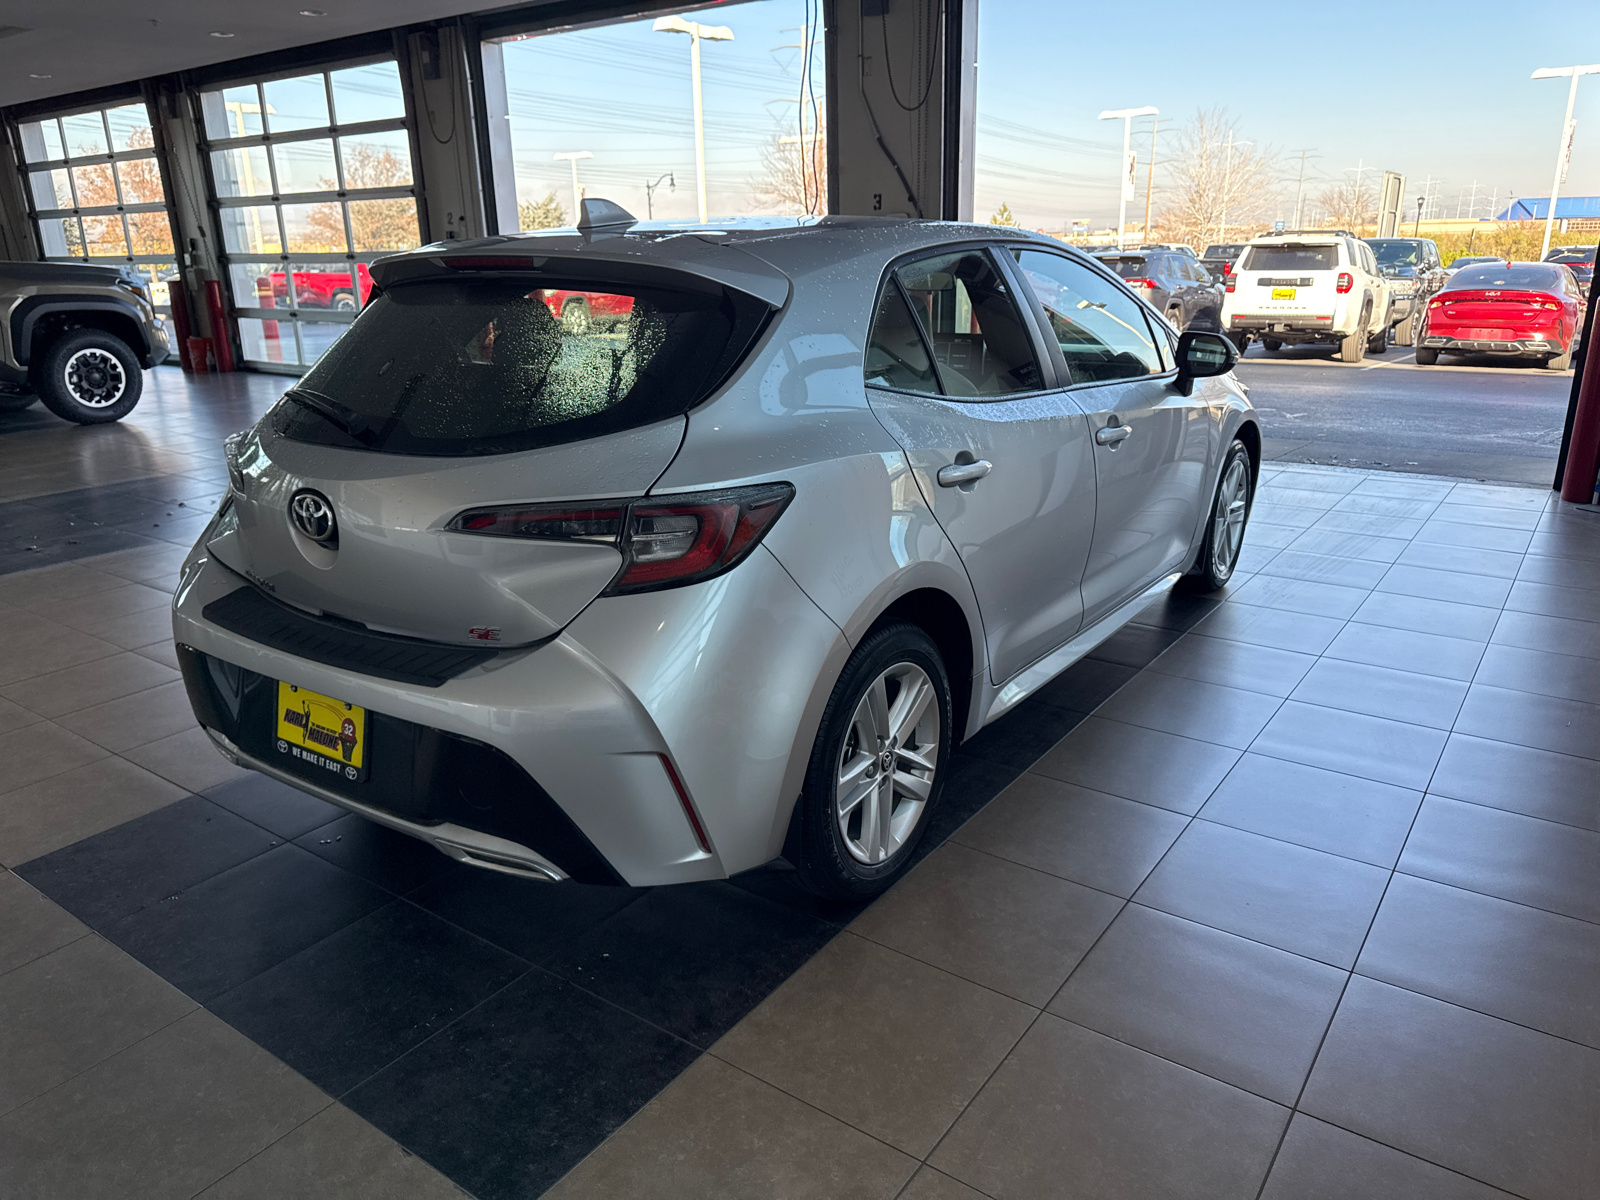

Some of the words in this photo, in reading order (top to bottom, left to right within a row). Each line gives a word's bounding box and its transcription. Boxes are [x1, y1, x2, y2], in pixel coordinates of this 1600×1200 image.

[873, 193, 882, 210] 3
[447, 211, 454, 225] 2
[283, 708, 305, 728] KARL
[307, 726, 340, 751] MALONE
[344, 724, 354, 736] 32
[292, 746, 301, 758] WE
[302, 750, 318, 764] MAKE
[319, 757, 325, 767] IT
[326, 760, 341, 773] EASY
